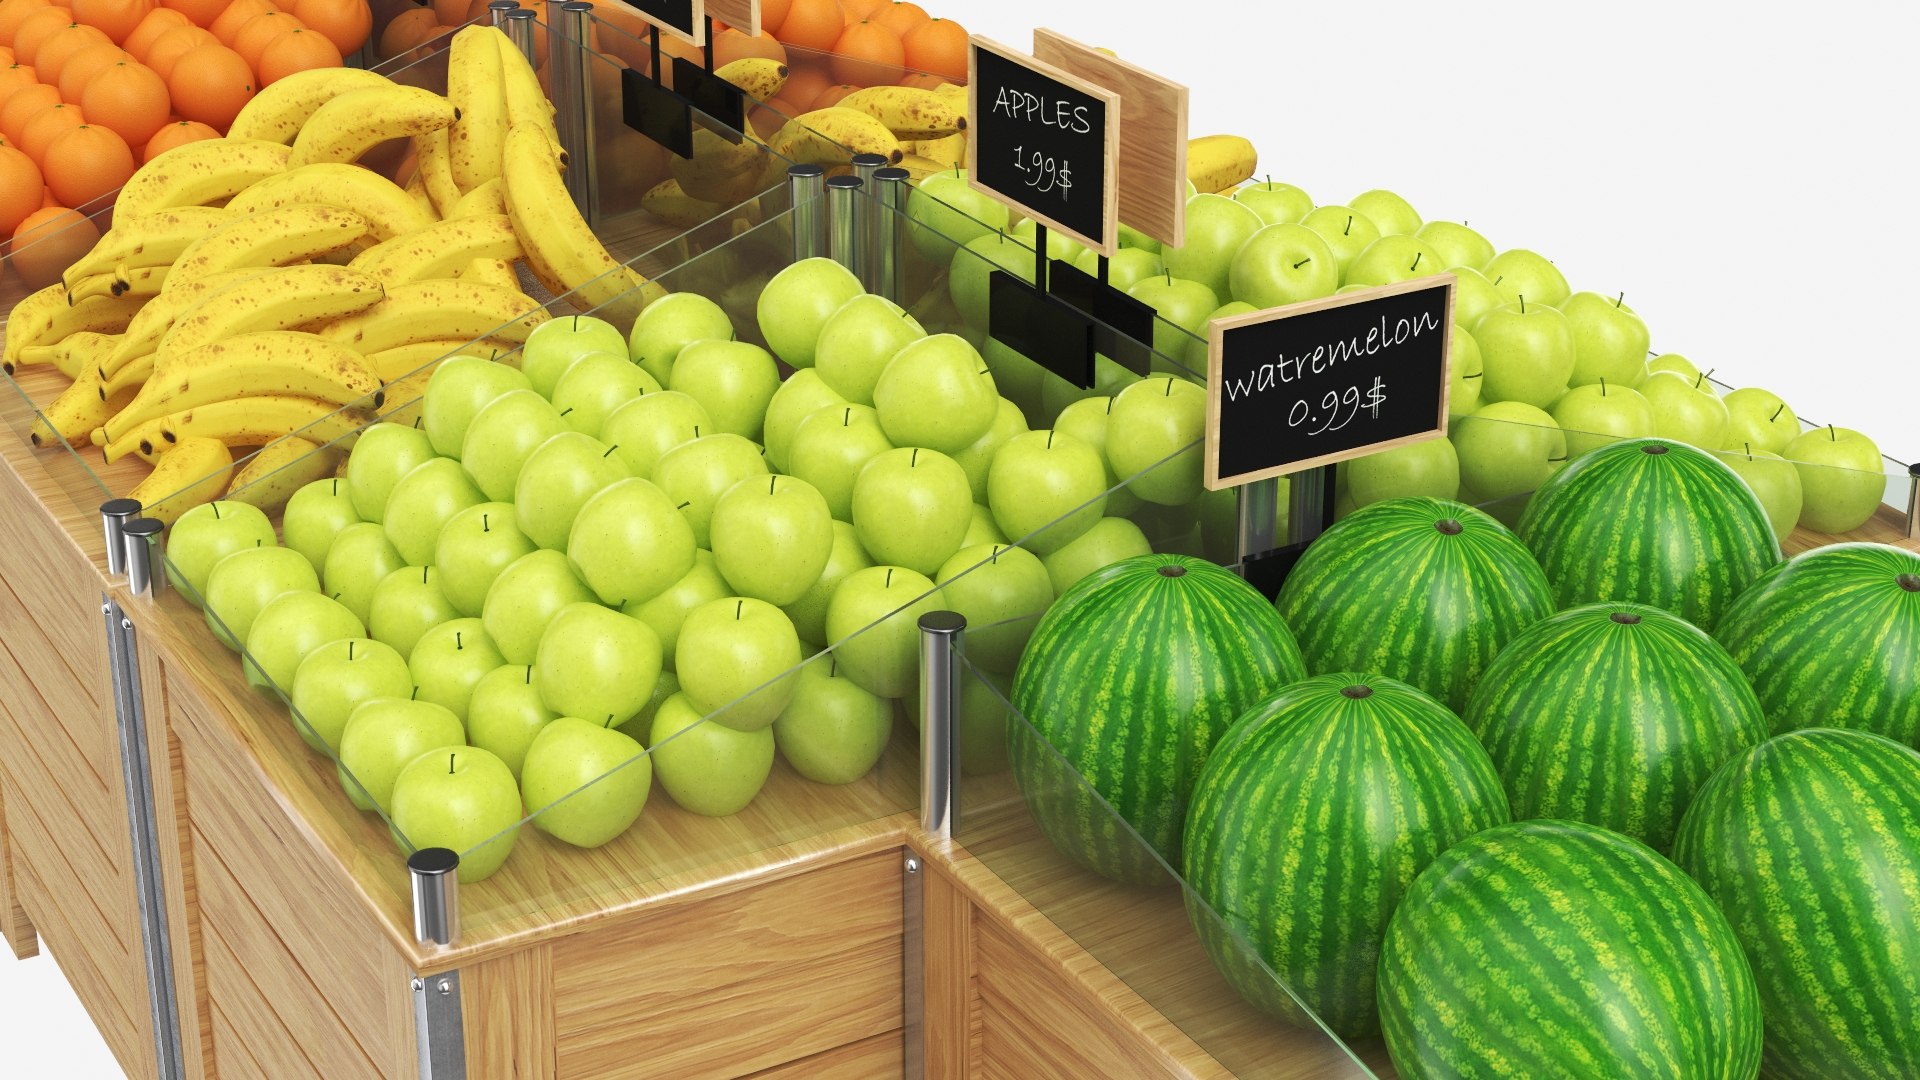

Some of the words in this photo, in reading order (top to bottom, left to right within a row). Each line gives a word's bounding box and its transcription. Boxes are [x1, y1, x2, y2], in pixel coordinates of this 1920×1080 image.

[993, 86, 1091, 134] APPLES
[1013, 145, 1073, 202] 1.99$
[1225, 311, 1439, 402] watremelon
[1288, 375, 1387, 436] 0.99$
